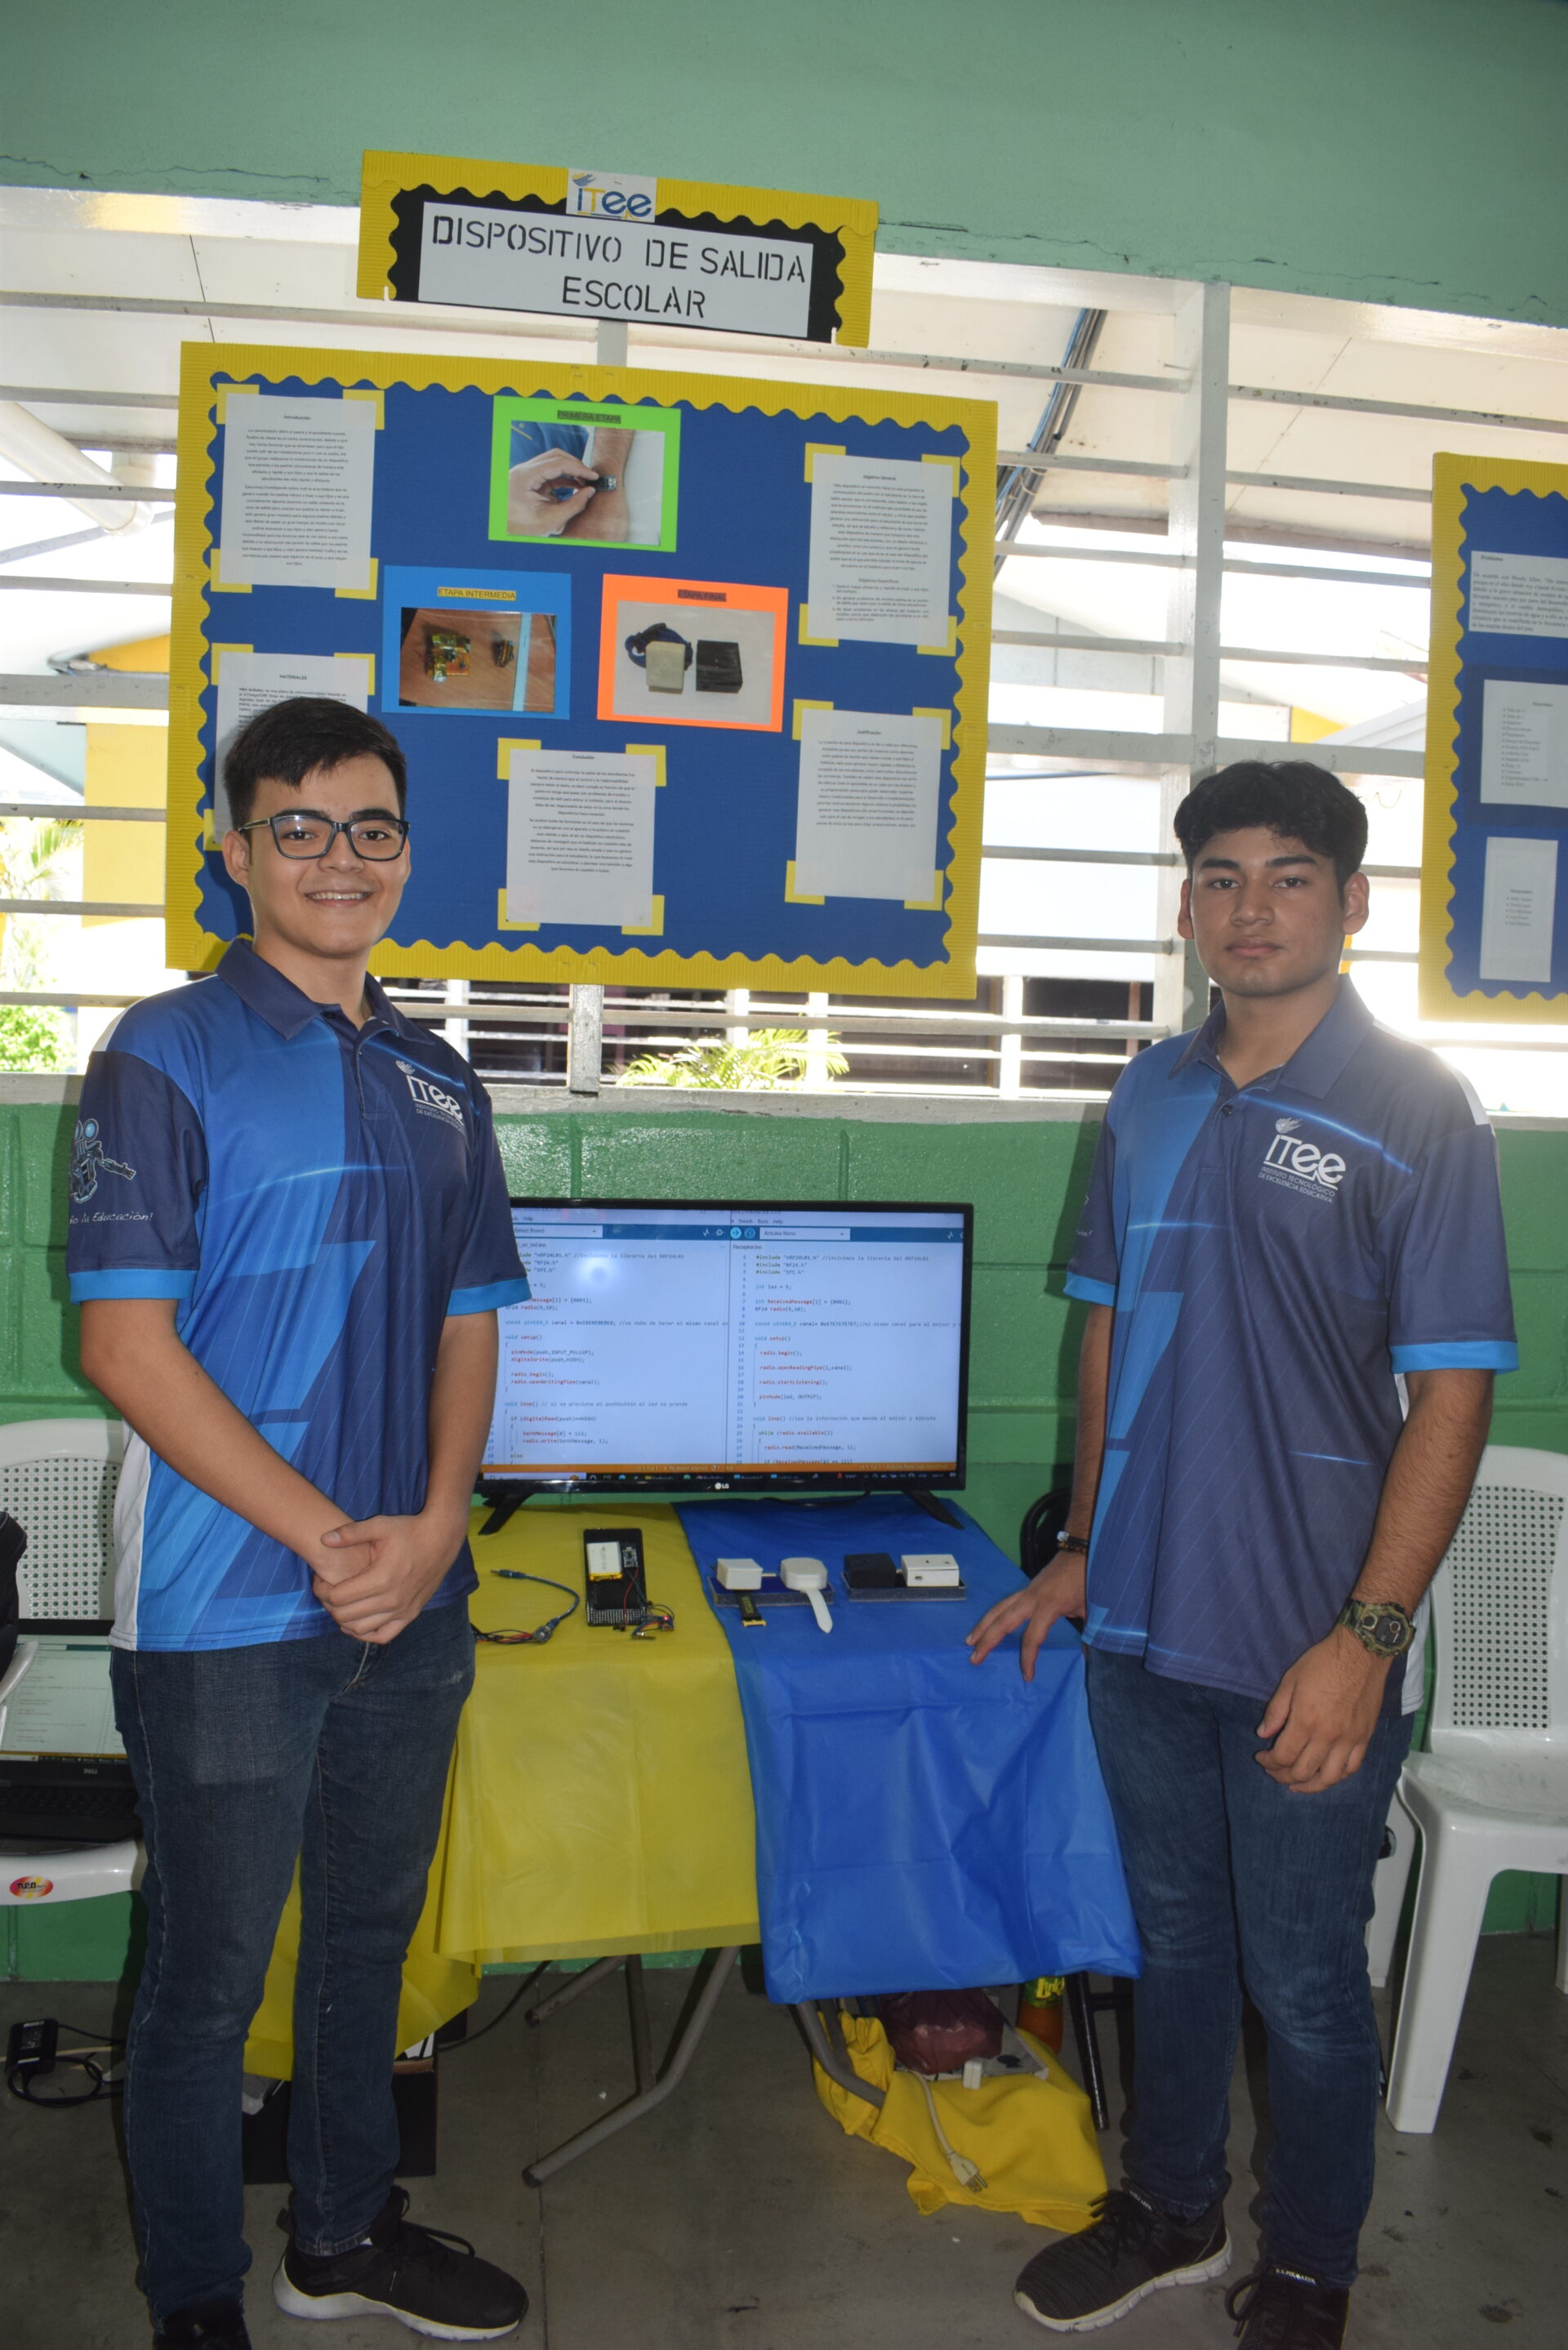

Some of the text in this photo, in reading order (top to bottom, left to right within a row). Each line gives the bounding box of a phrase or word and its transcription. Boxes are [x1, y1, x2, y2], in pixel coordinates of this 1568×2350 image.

[432, 215, 806, 283] DISPOSITIVO DE SALIDA
[562, 276, 706, 318] ESCOLAR
[557, 411, 621, 423] PRIMERA ETAPA
[438, 588, 515, 600] ETAPA INTERMEDIA
[1261, 1166, 1287, 1179] INSTITUTO
[1266, 1175, 1298, 1191] EXCELENCIA
[1299, 1187, 1333, 1203] EDUCATIVA
[92, 1211, 154, 1222] Educación!
